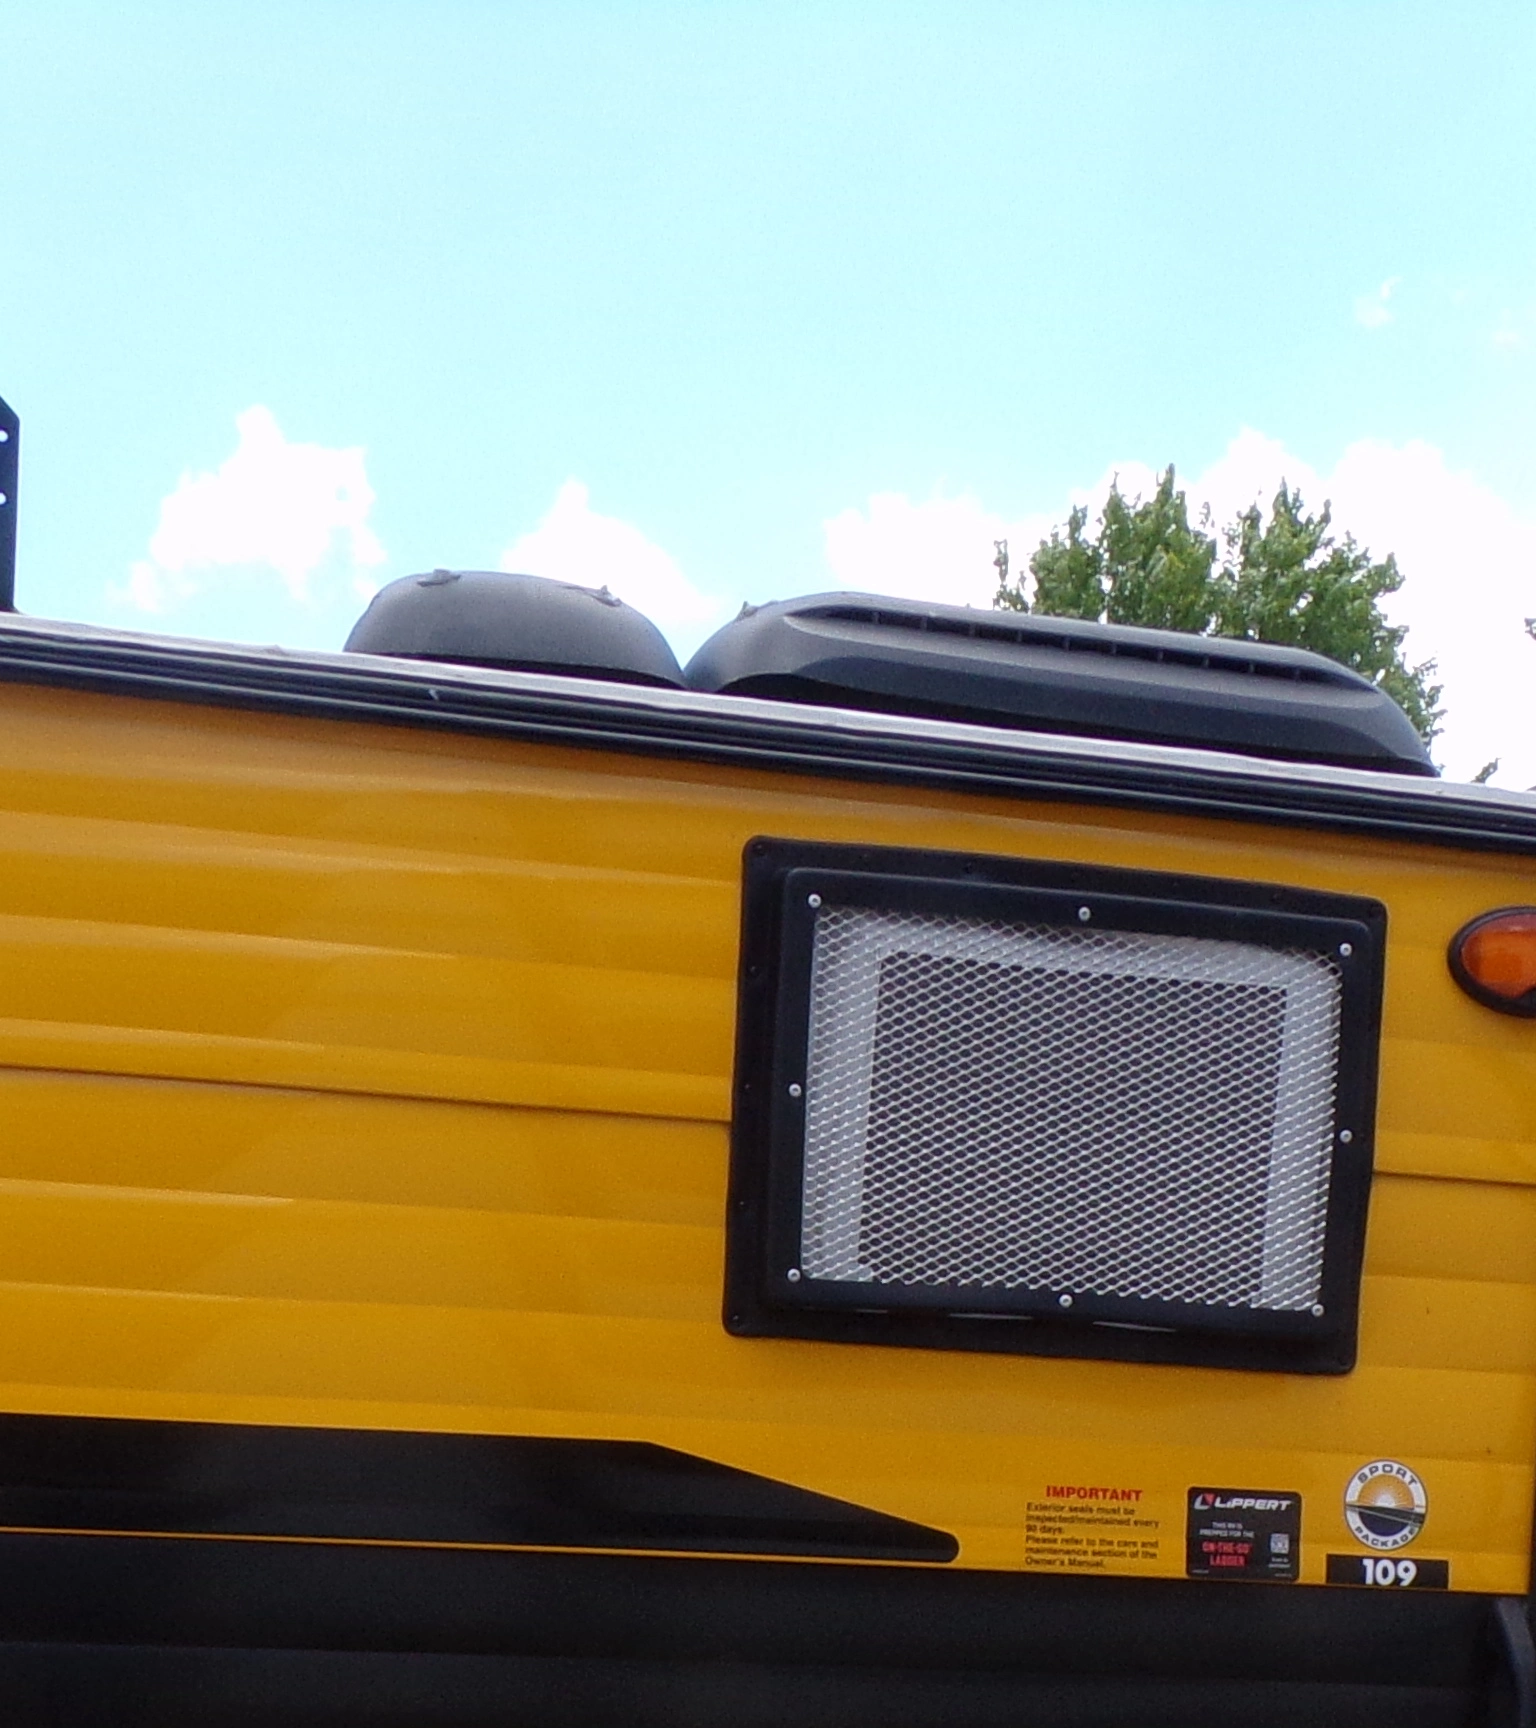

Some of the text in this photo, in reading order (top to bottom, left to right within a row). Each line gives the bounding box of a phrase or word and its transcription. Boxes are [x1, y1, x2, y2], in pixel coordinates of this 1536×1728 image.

[1357, 1463, 1417, 1487] SPORT
[1046, 1485, 1143, 1501] IMPORTANT
[1214, 1496, 1292, 1511] LIPPERT
[1354, 1526, 1417, 1548] PACKAGE
[1362, 1558, 1417, 1587] 109
